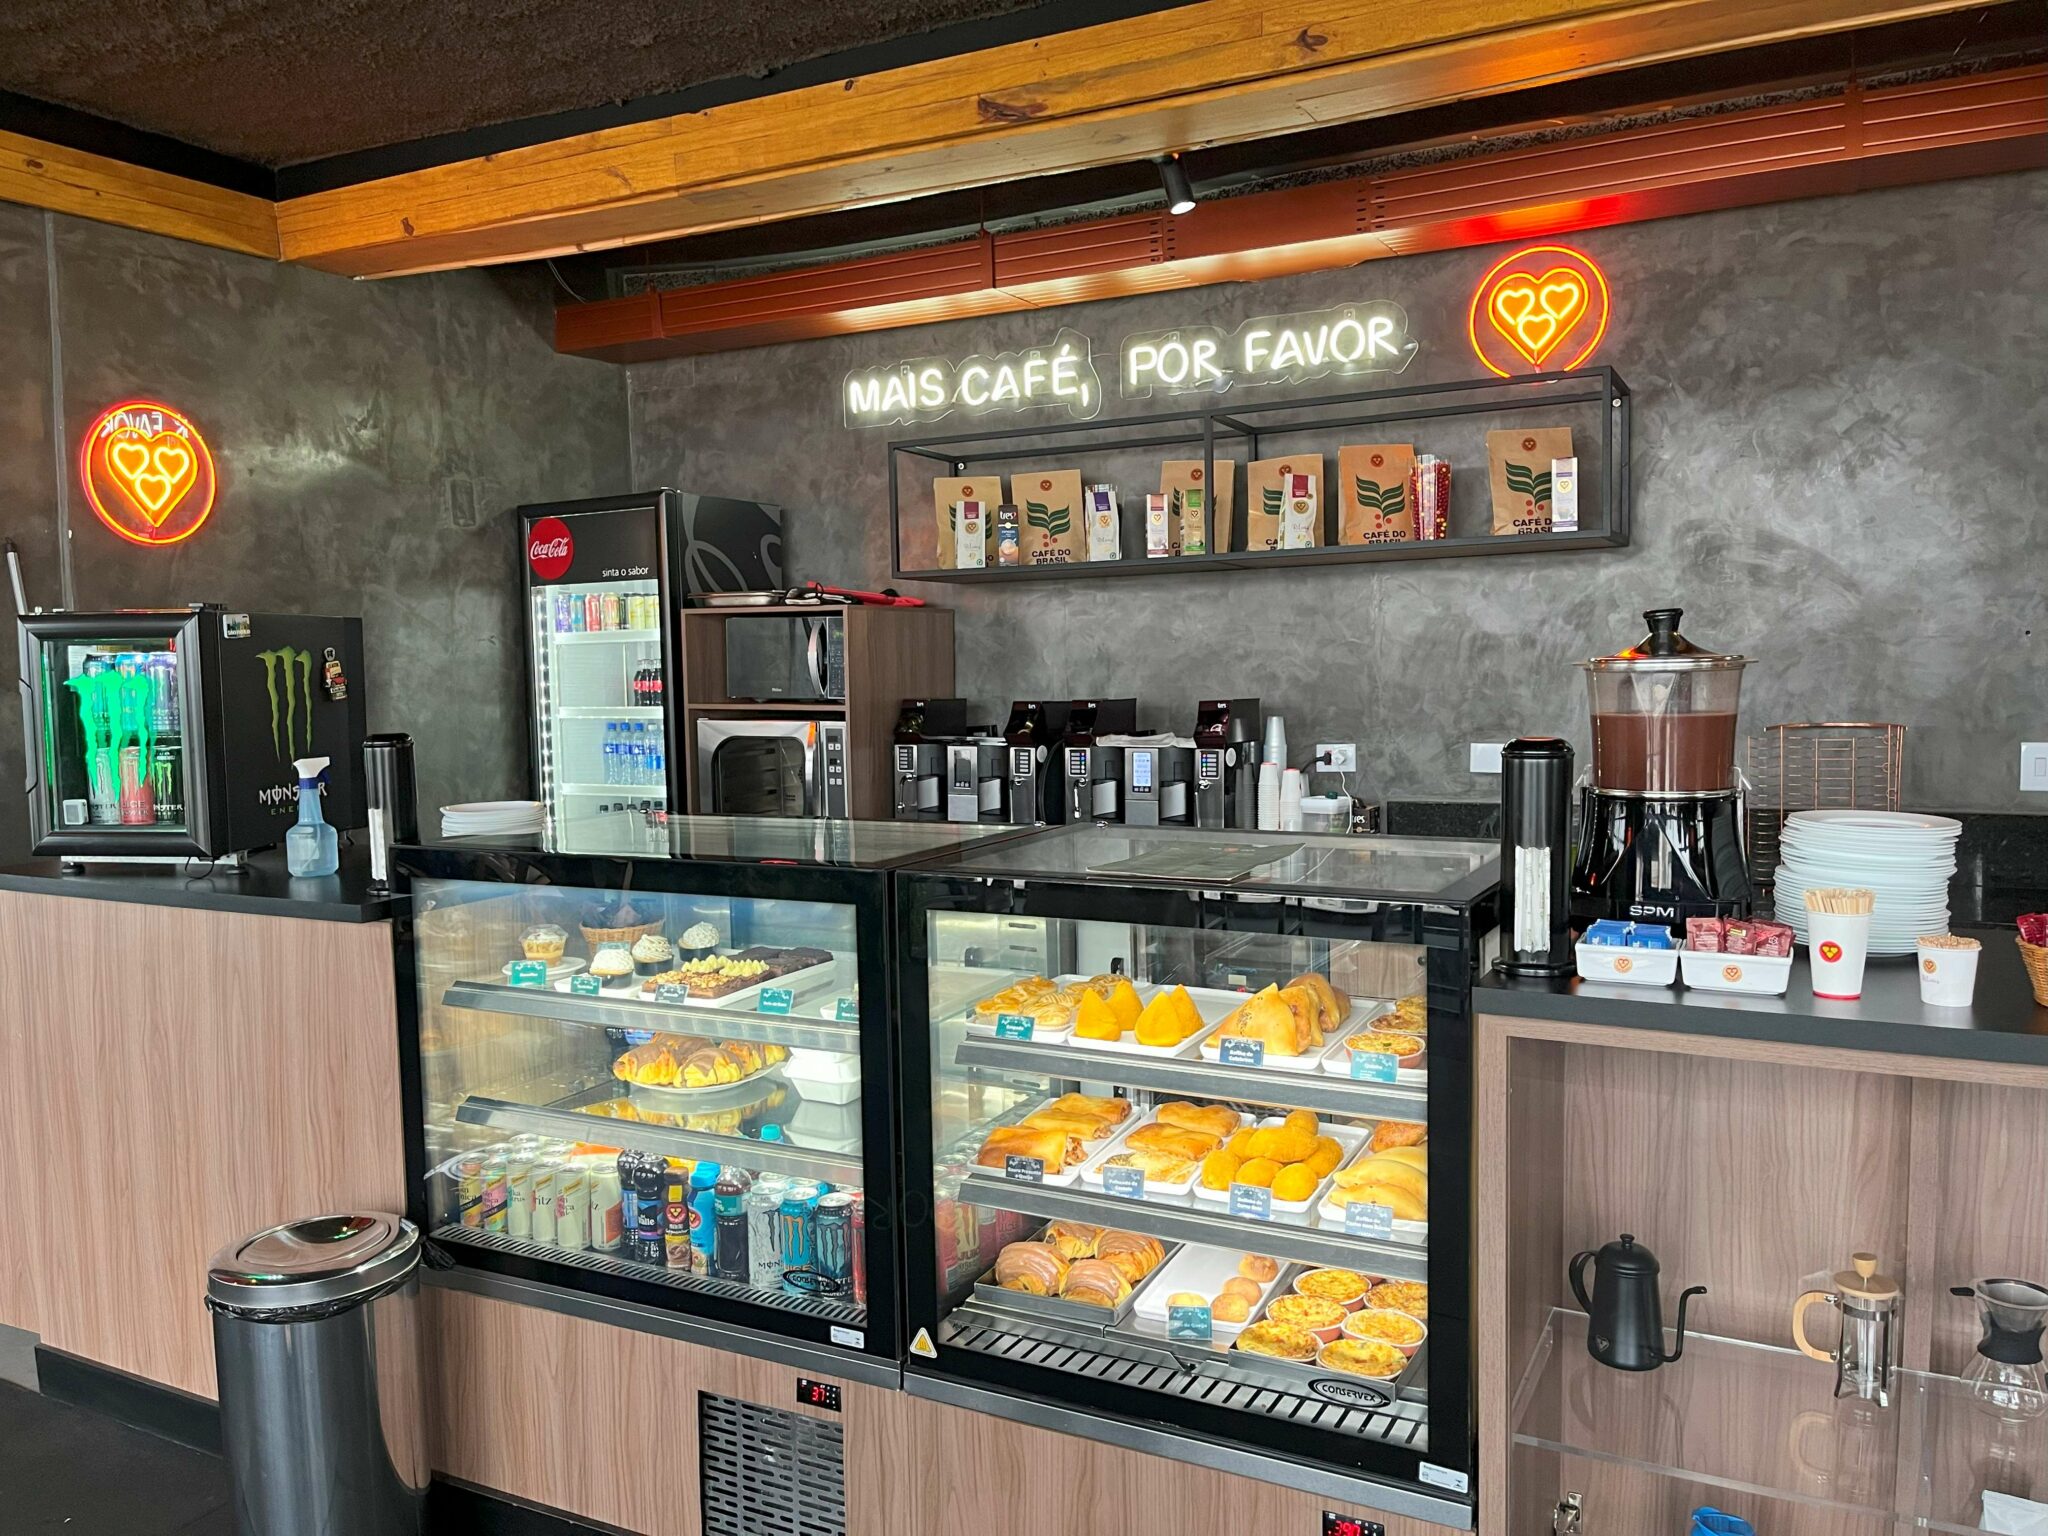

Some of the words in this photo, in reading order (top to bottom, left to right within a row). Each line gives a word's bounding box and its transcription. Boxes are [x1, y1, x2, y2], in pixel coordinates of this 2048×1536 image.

[849, 368, 946, 414] MAIS
[960, 343, 1090, 407] CAFÉ,
[1128, 339, 1223, 387] POR
[1244, 316, 1398, 374] FAVOR
[1512, 516, 1542, 527] CAFÉ
[1363, 529, 1390, 539] CAFÉ
[1392, 530, 1406, 538] DO
[1032, 547, 1056, 557] CAFÉ
[1057, 548, 1071, 556] DO
[602, 568, 619, 577] sinta
[621, 568, 627, 576] o
[628, 565, 649, 576] sabor
[1629, 905, 1674, 918] SPM
[1322, 1384, 1376, 1402] CONSERVEX
